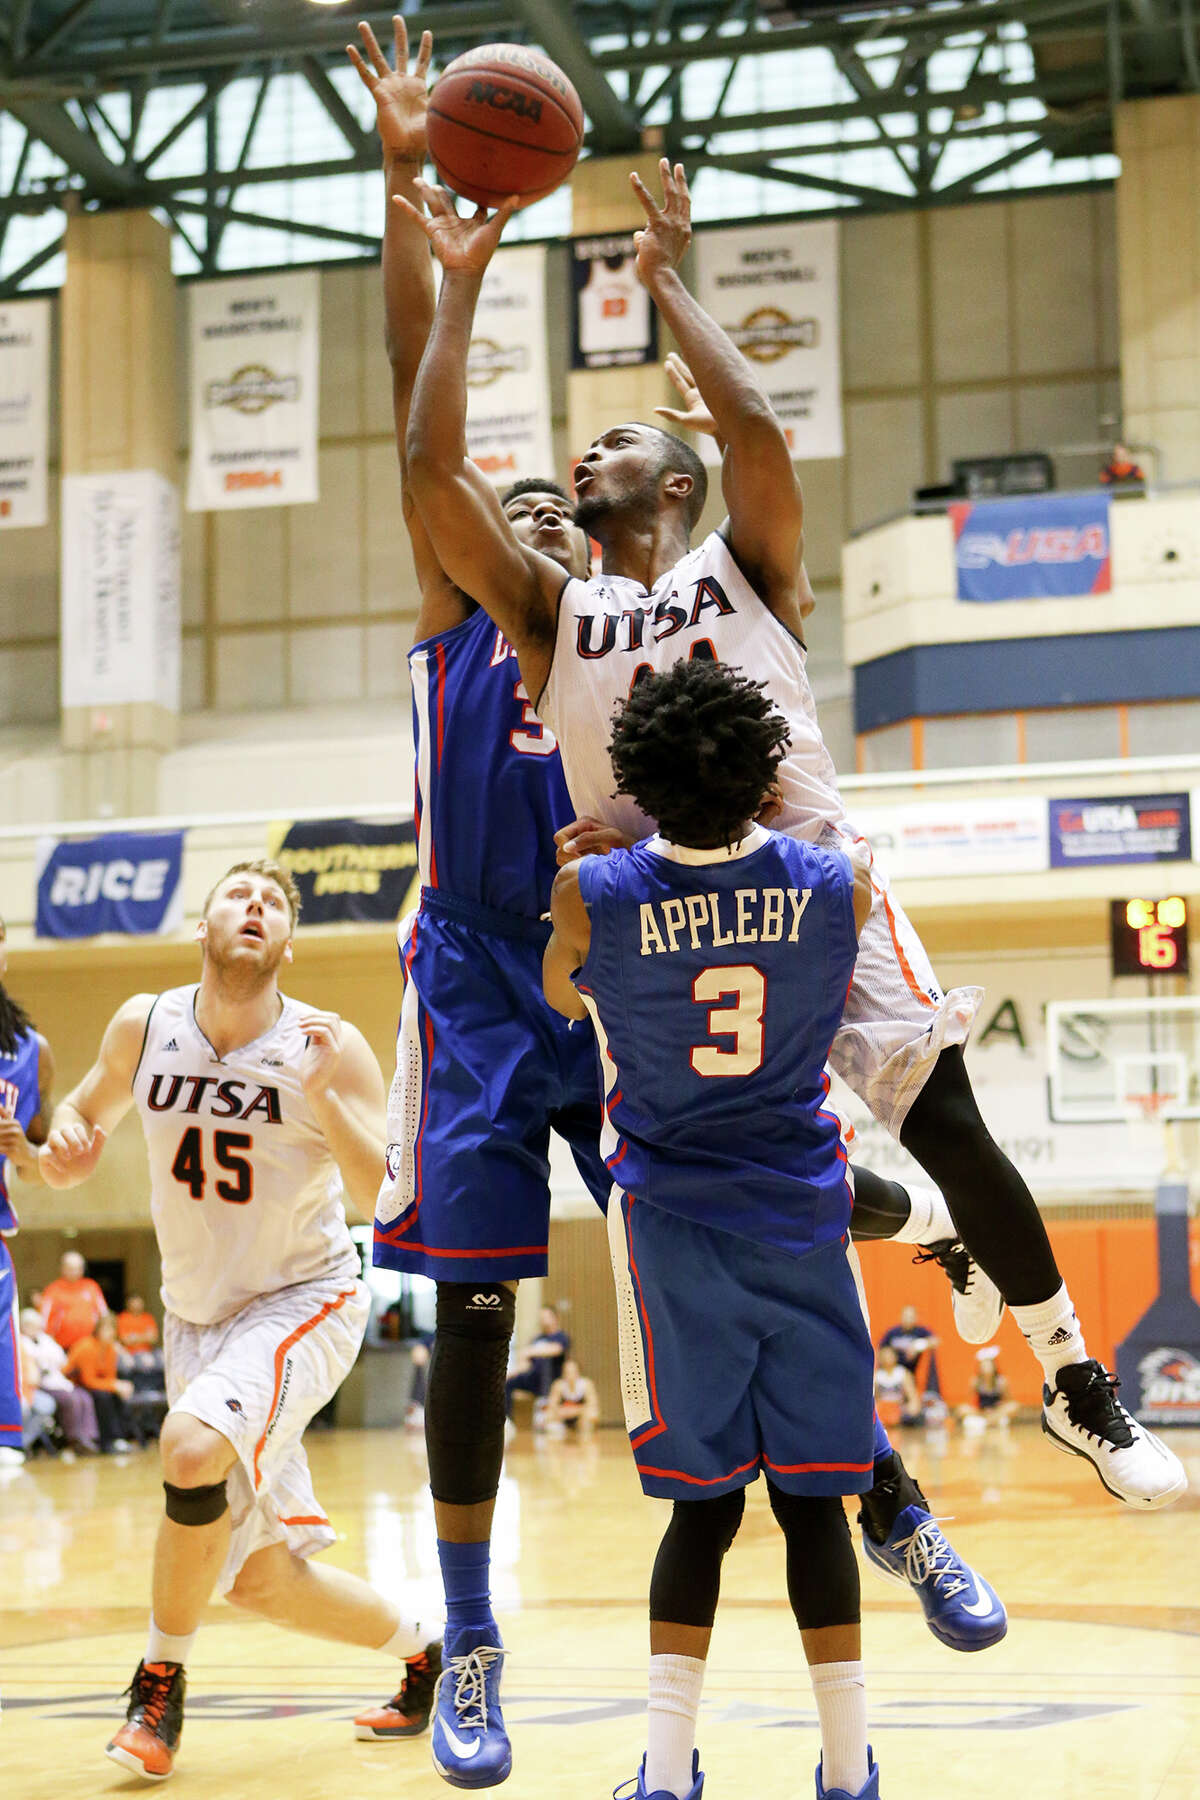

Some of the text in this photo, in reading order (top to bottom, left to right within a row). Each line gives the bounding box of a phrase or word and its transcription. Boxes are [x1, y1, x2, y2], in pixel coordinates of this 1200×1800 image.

[466, 81, 542, 124] NCAA
[573, 575, 737, 660] UTSA
[50, 858, 171, 907] RICE
[639, 887, 812, 956] APPLEBY
[689, 962, 768, 1079] 3
[146, 1073, 284, 1125] UTSA
[170, 1126, 254, 1205] 45
[1047, 1332, 1073, 1346] adidas
